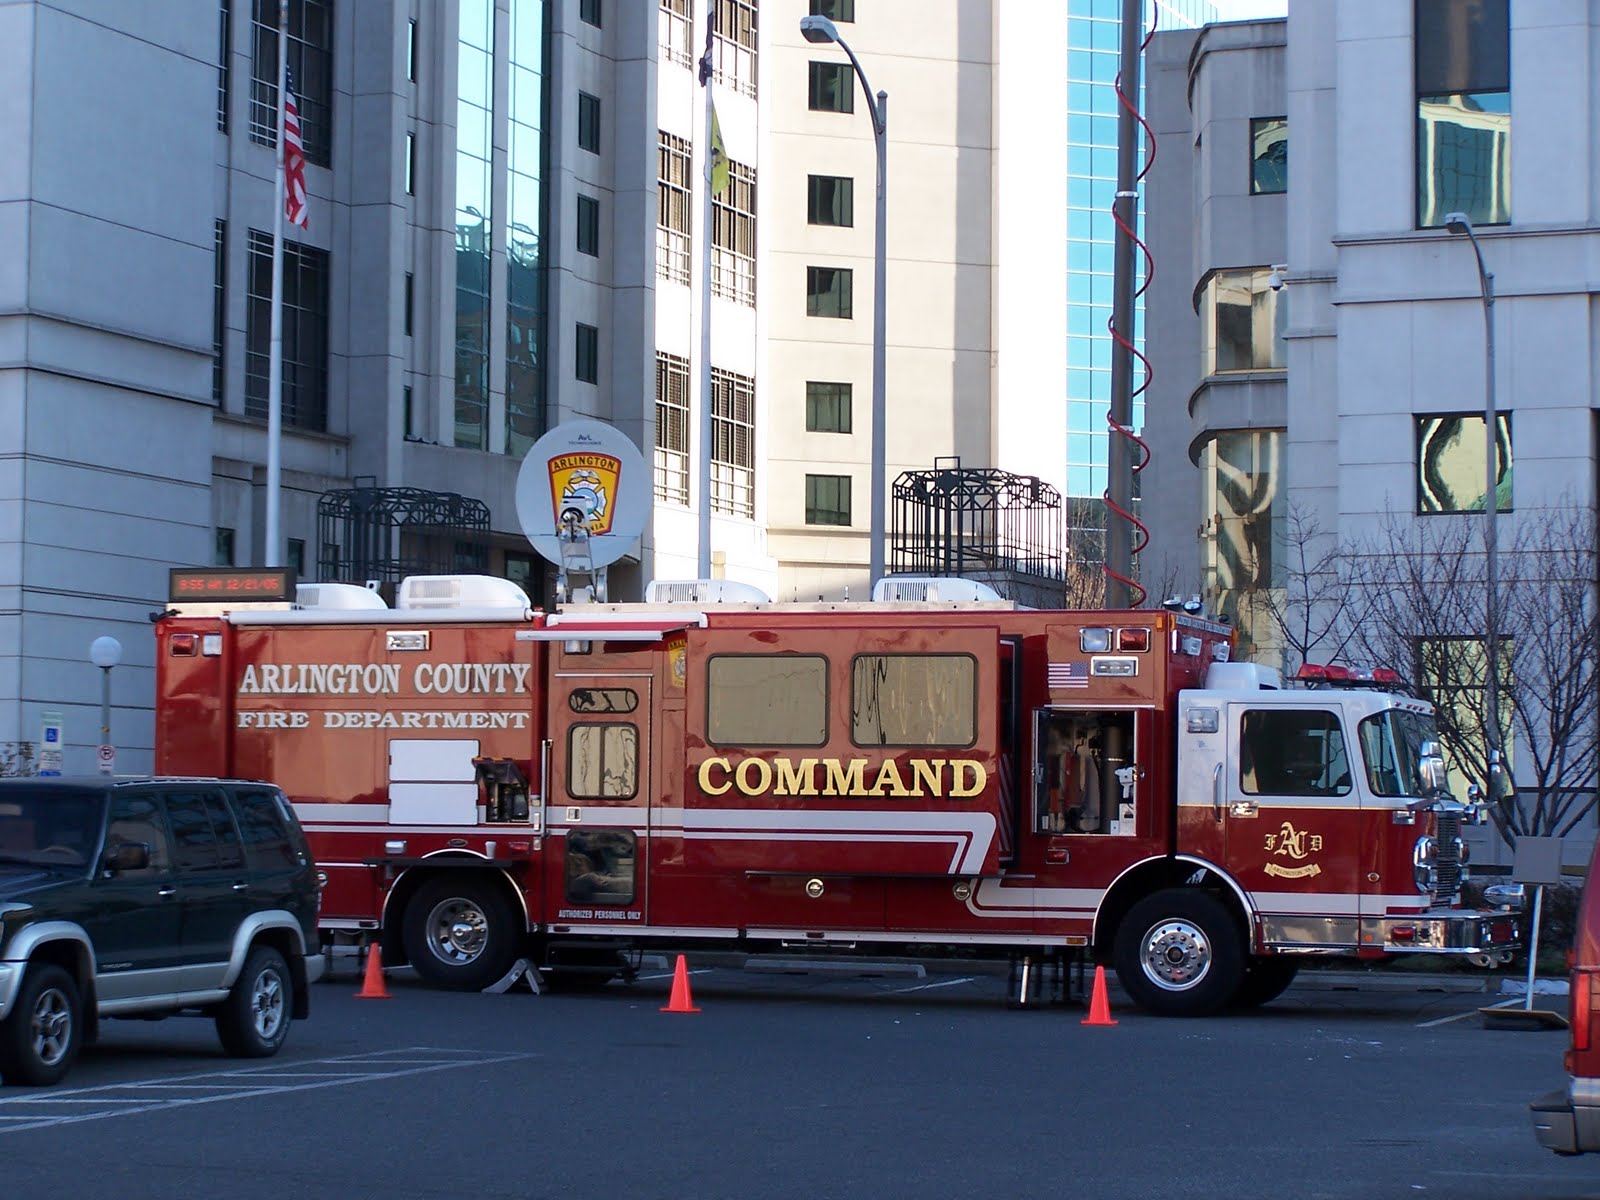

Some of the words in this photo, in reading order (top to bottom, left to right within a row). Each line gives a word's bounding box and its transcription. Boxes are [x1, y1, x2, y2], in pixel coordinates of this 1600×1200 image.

[554, 457, 615, 469] ARLINGTON
[239, 664, 402, 694] ARLINGTON
[414, 663, 531, 693] COUNTY
[237, 711, 309, 729] FIRE
[323, 712, 530, 729] DEPARTMENT
[698, 757, 987, 797] COMMAND
[558, 910, 593, 919] AUTHORIZED
[594, 910, 626, 919] PERSONNEL
[627, 911, 641, 920] ONLY
